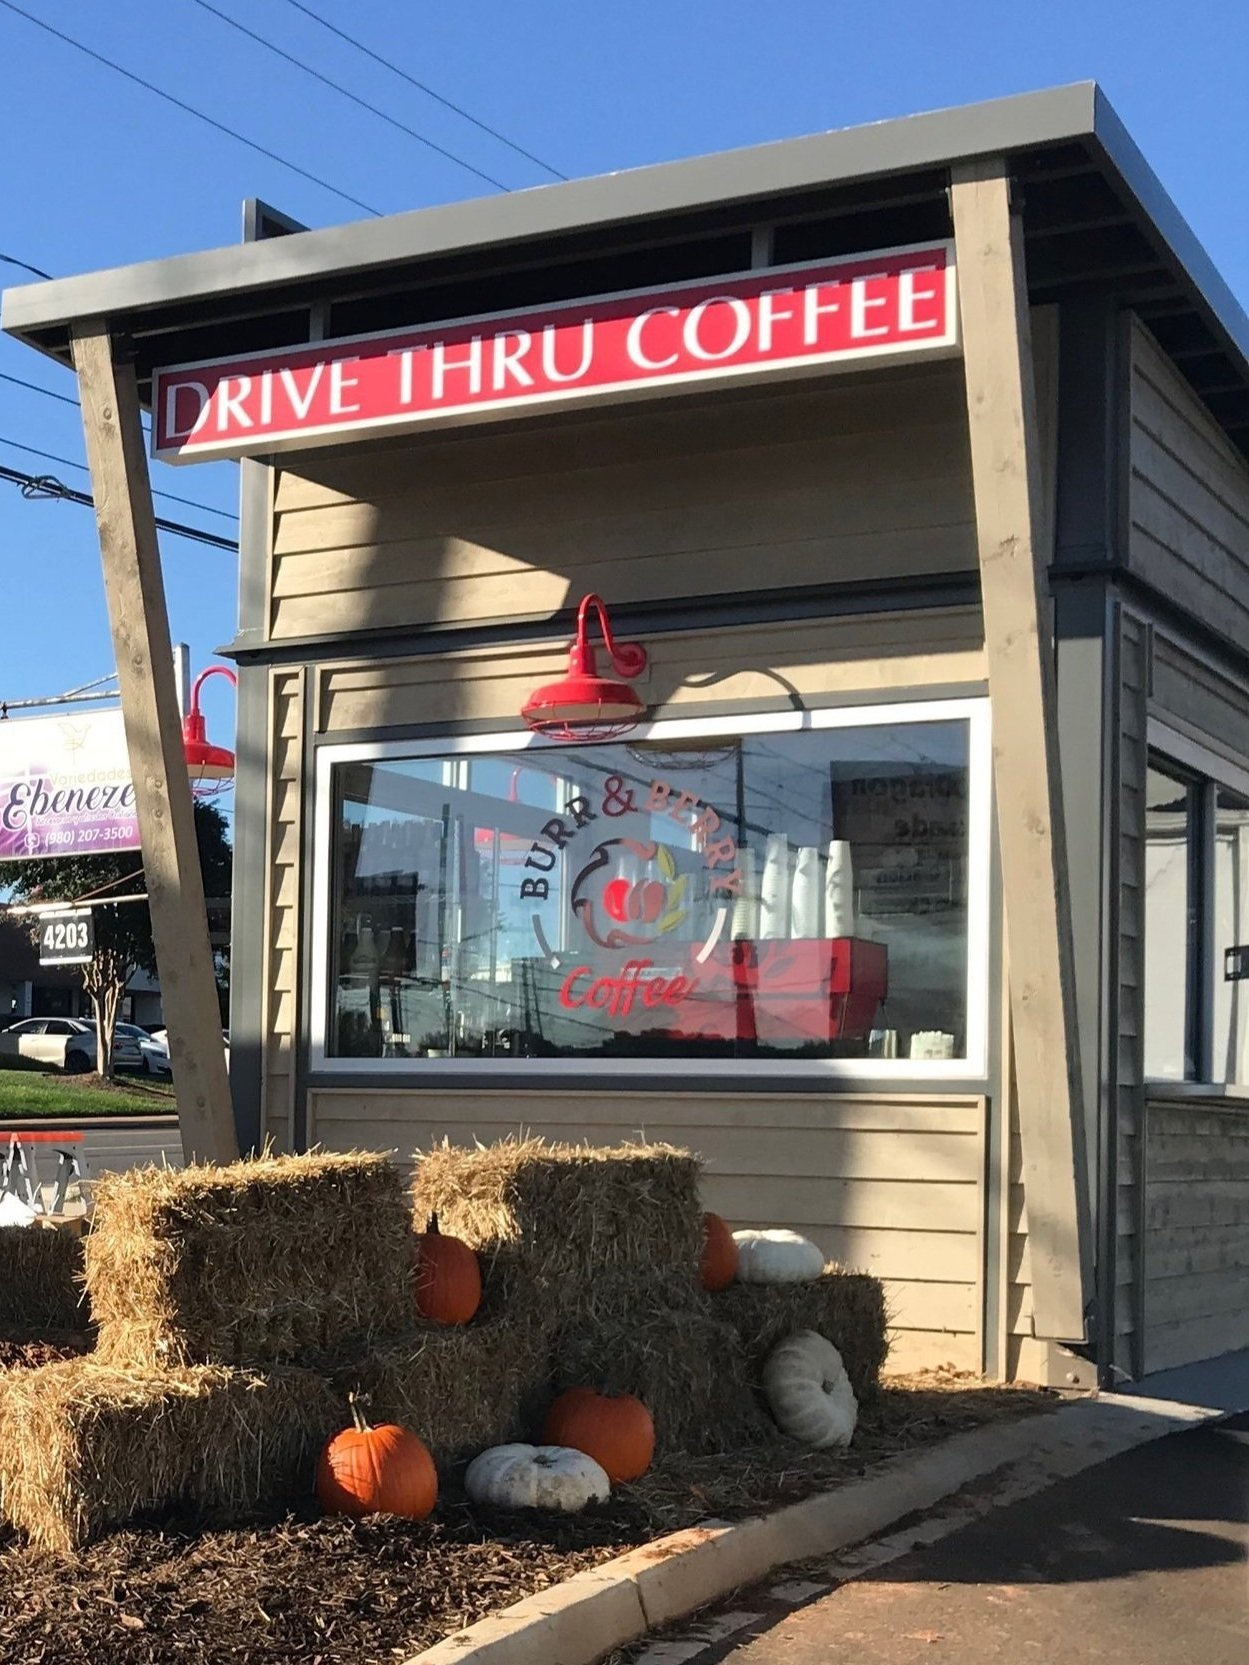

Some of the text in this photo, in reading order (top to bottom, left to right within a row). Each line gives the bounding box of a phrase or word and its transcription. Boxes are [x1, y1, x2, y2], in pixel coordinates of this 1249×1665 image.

[165, 265, 937, 439] DRIVE THRU COFFEE
[2, 778, 136, 829] Ebeneze
[45, 827, 133, 847] (980) 207-3500
[520, 775, 743, 900] BURR & BERRY
[44, 923, 88, 949] 4203
[559, 958, 700, 1017] Coffee
